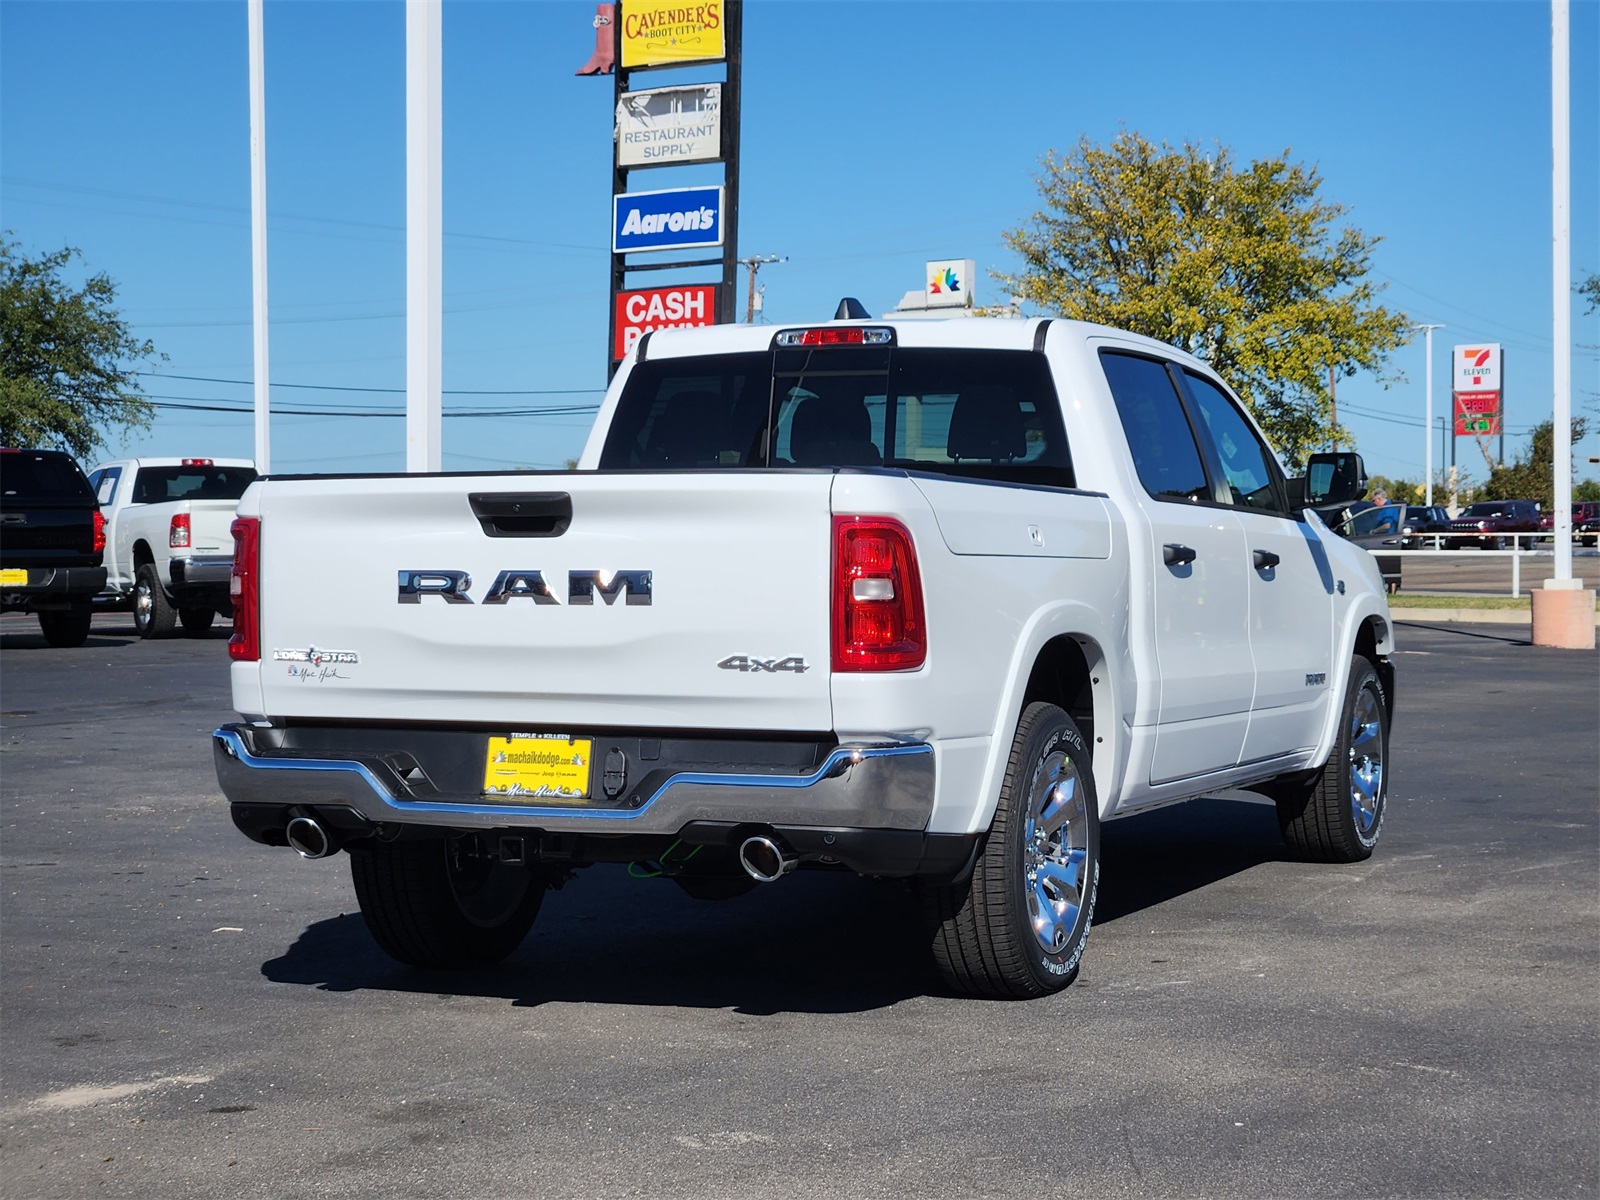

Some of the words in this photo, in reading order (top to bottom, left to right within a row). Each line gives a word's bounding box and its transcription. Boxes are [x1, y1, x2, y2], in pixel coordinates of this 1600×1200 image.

[625, 3, 719, 39] CAVENDER'S
[650, 28, 672, 38] BOOT
[675, 24, 697, 35] CITY
[624, 124, 714, 143] RESTAURANT
[643, 143, 695, 158] SUPPLY
[621, 206, 714, 236] Aaron's
[626, 290, 704, 323] CASH
[1464, 349, 1490, 367] 7
[397, 569, 653, 606] RAM
[273, 649, 308, 662] LONE
[320, 652, 359, 664] STAR
[300, 668, 317, 682] Mac
[507, 751, 571, 767] machaikdodge.com
